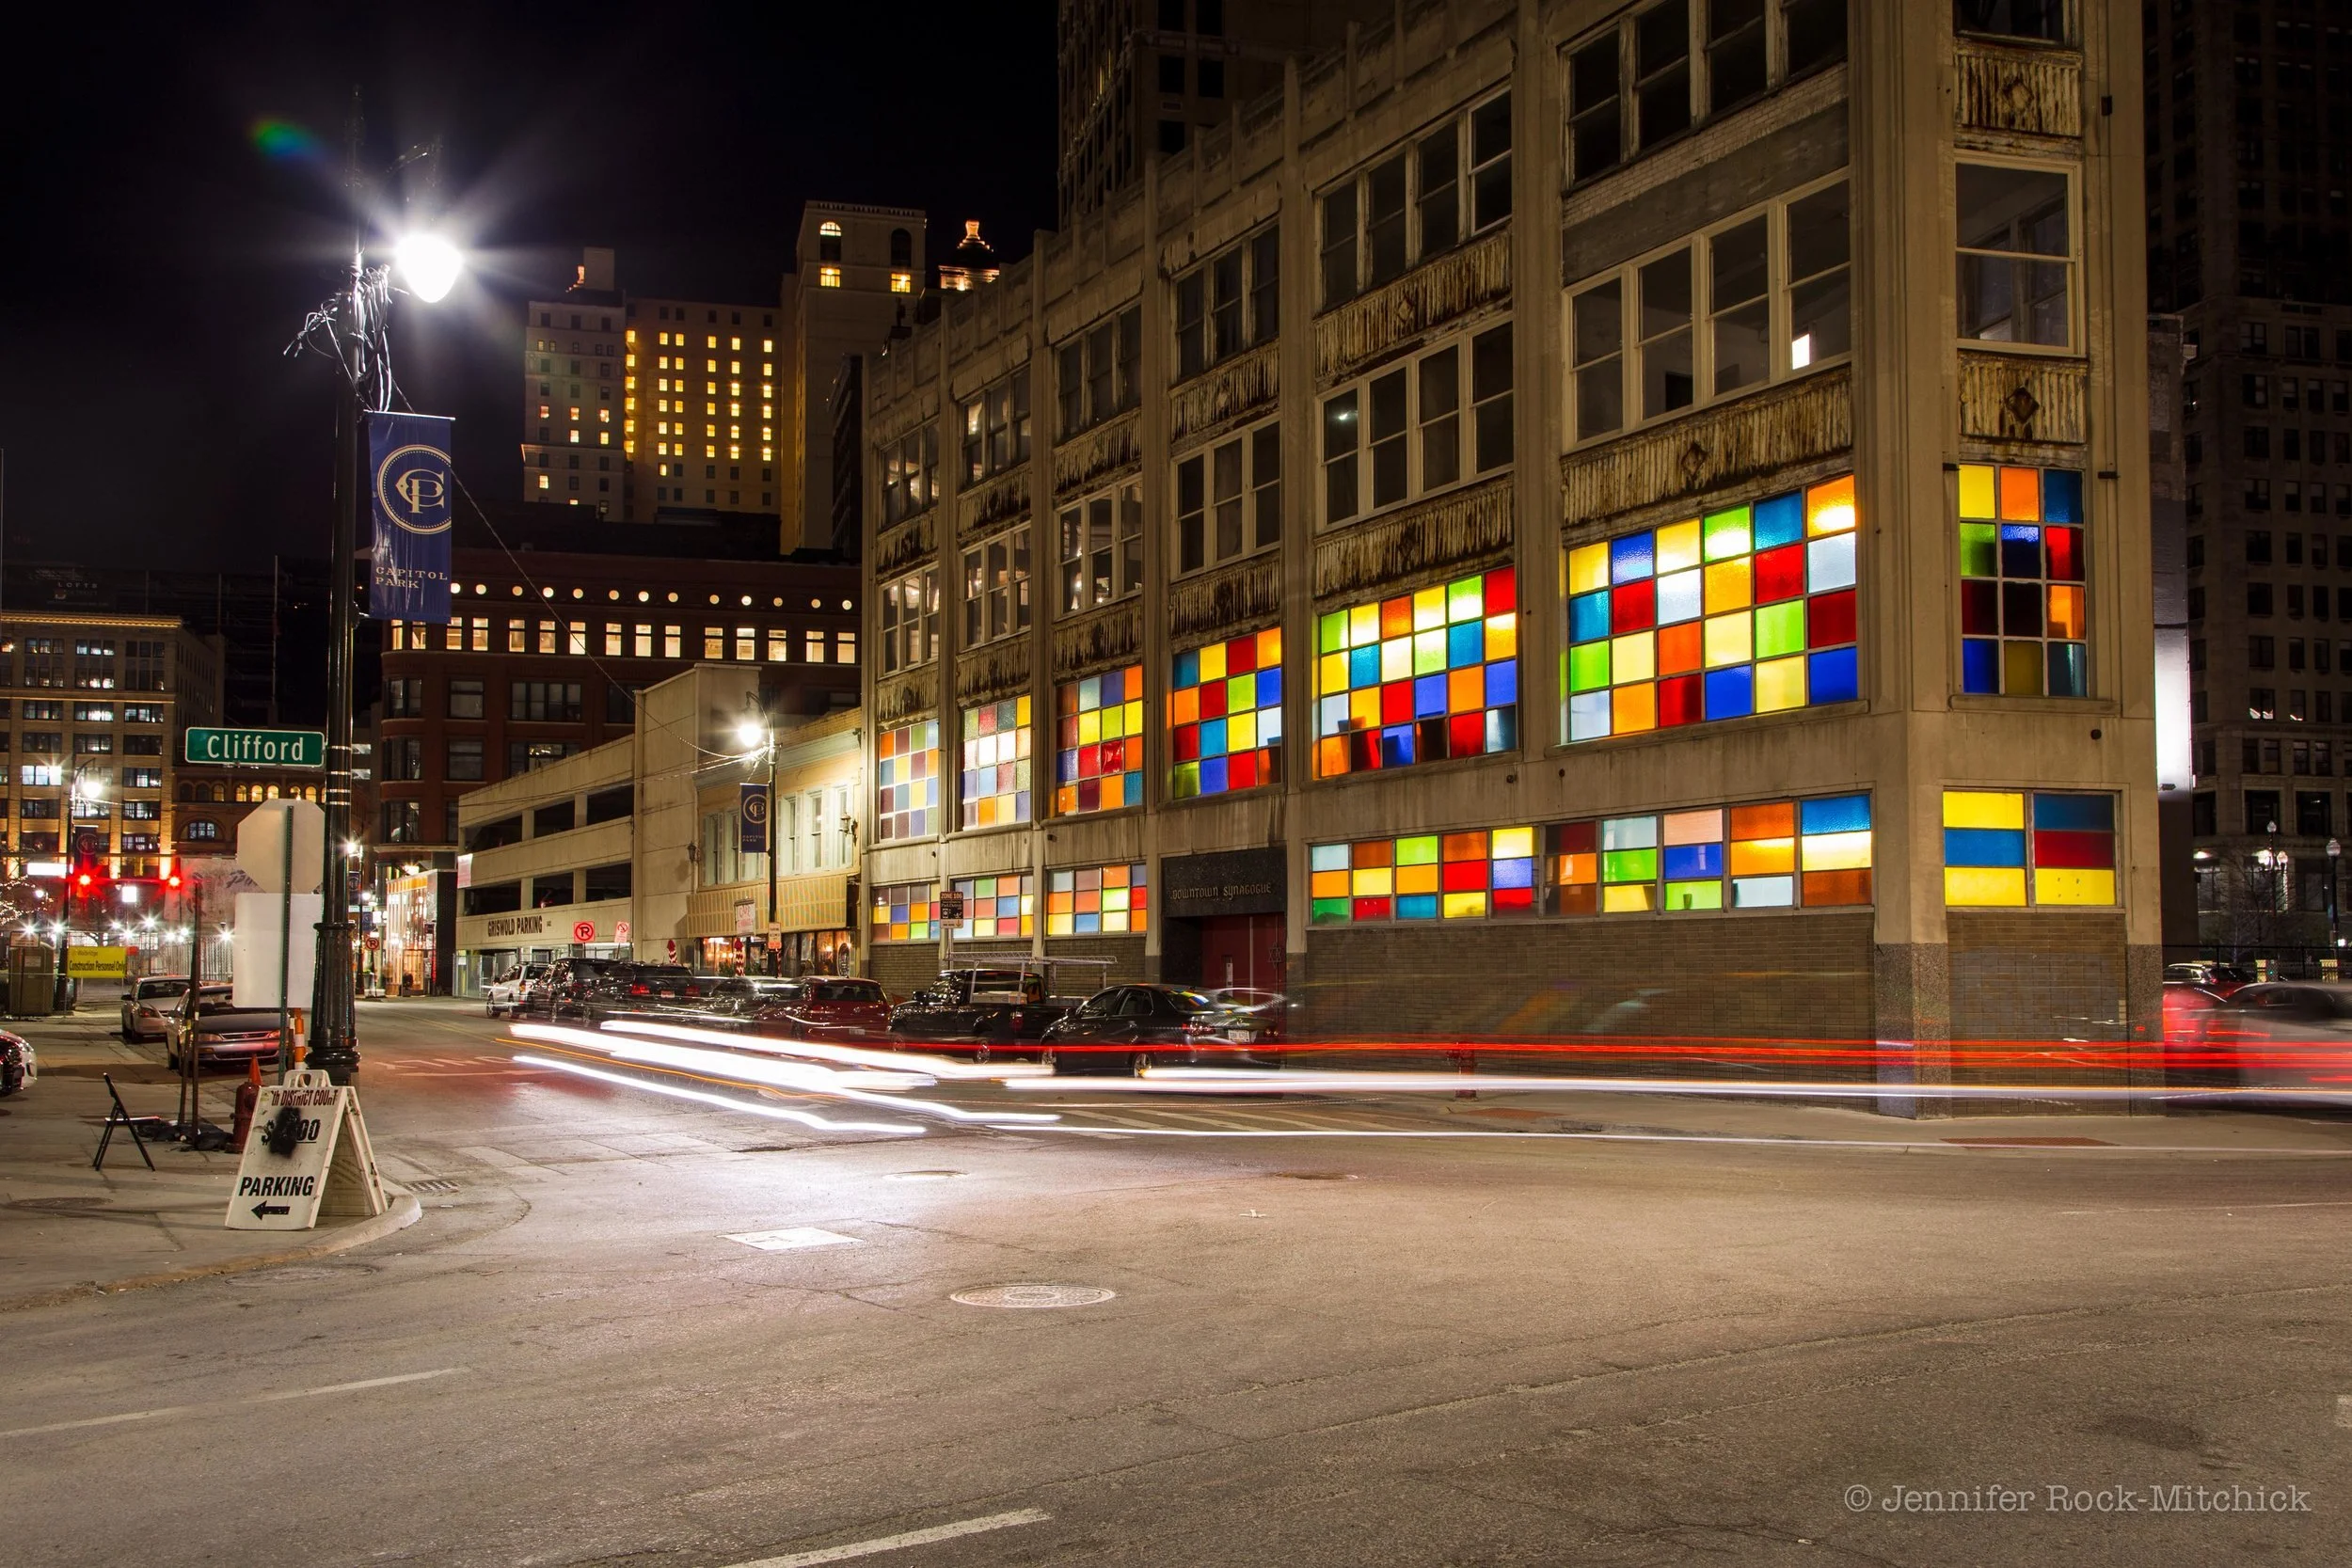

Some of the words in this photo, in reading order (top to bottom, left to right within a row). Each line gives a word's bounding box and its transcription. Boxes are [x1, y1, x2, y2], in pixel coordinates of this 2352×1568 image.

[375, 566, 449, 581] CAPITOL
[375, 577, 421, 589] PARK
[207, 735, 304, 761] Clifford
[487, 918, 516, 937] GRISWOLD
[516, 915, 543, 935] PARKING
[69, 960, 95, 972] Construction
[95, 960, 115, 972] Personnel
[116, 960, 127, 974] Only
[238, 1176, 315, 1196] PARKING
